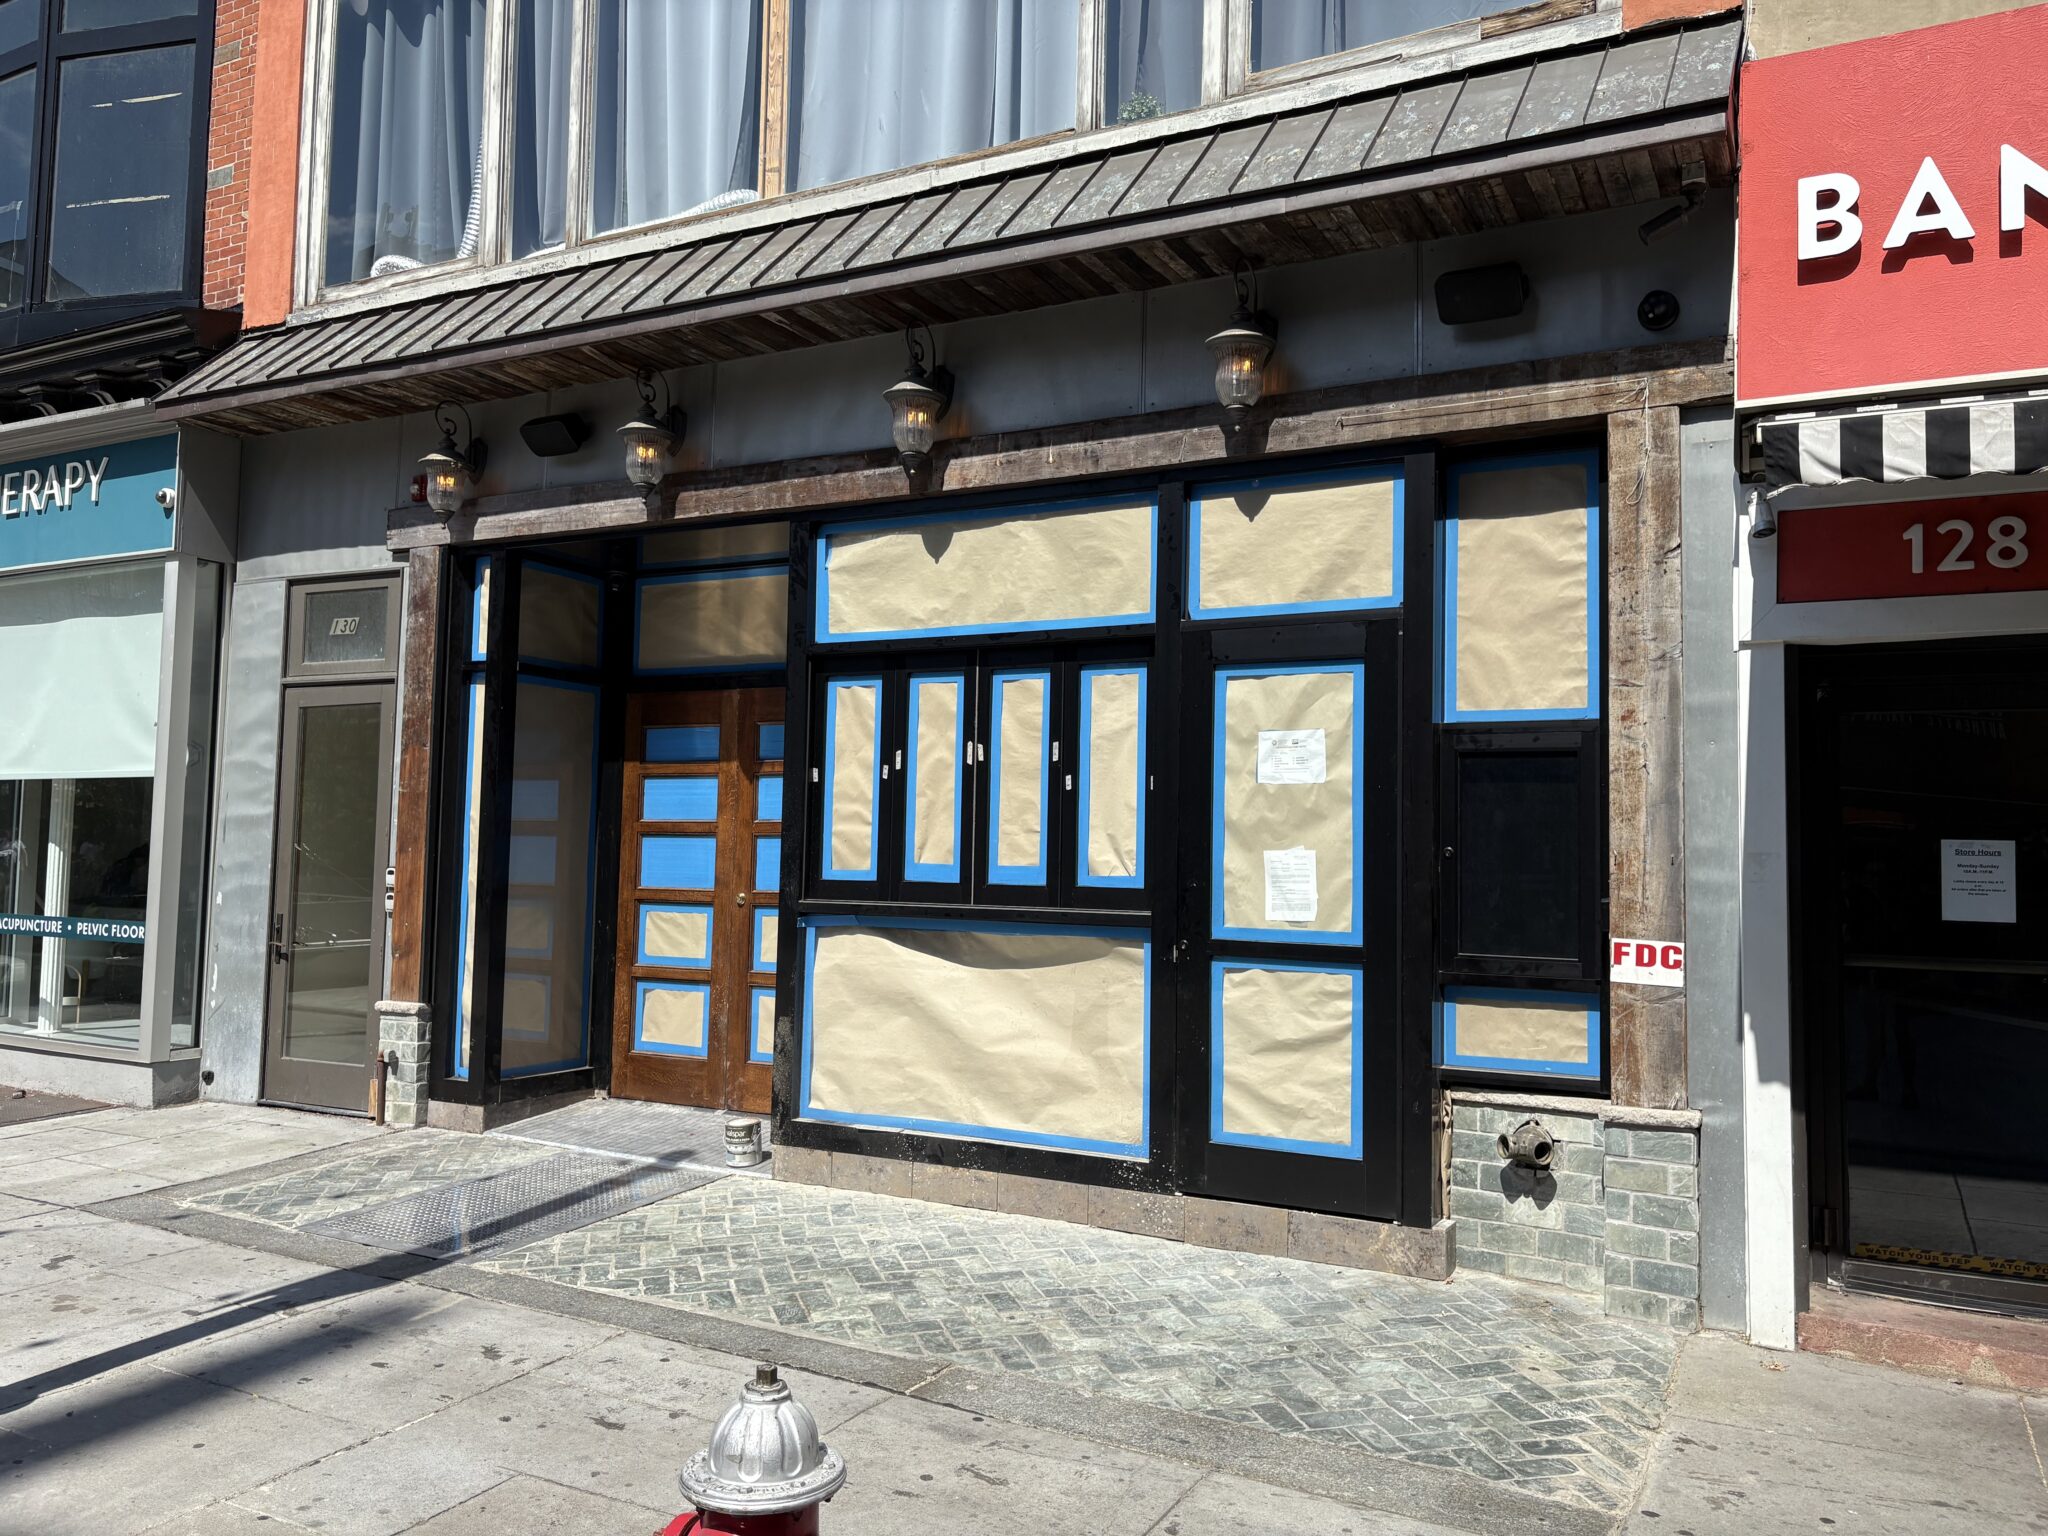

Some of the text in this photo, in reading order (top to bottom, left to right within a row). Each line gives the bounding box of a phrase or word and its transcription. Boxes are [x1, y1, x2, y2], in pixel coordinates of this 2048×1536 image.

[0, 457, 109, 514] ERAPY
[1902, 516, 2029, 574] 128
[333, 619, 357, 634] 130
[1954, 848, 2002, 857] Store Hours
[77, 922, 109, 936] PELVIC
[111, 925, 145, 939] FLOOR
[1613, 942, 1683, 970] FDC
[1865, 1247, 1905, 1257] WATCH
[1908, 1252, 1939, 1262] YOUR
[1942, 1256, 1971, 1265] STEP
[1989, 1261, 2031, 1272] WATCH
